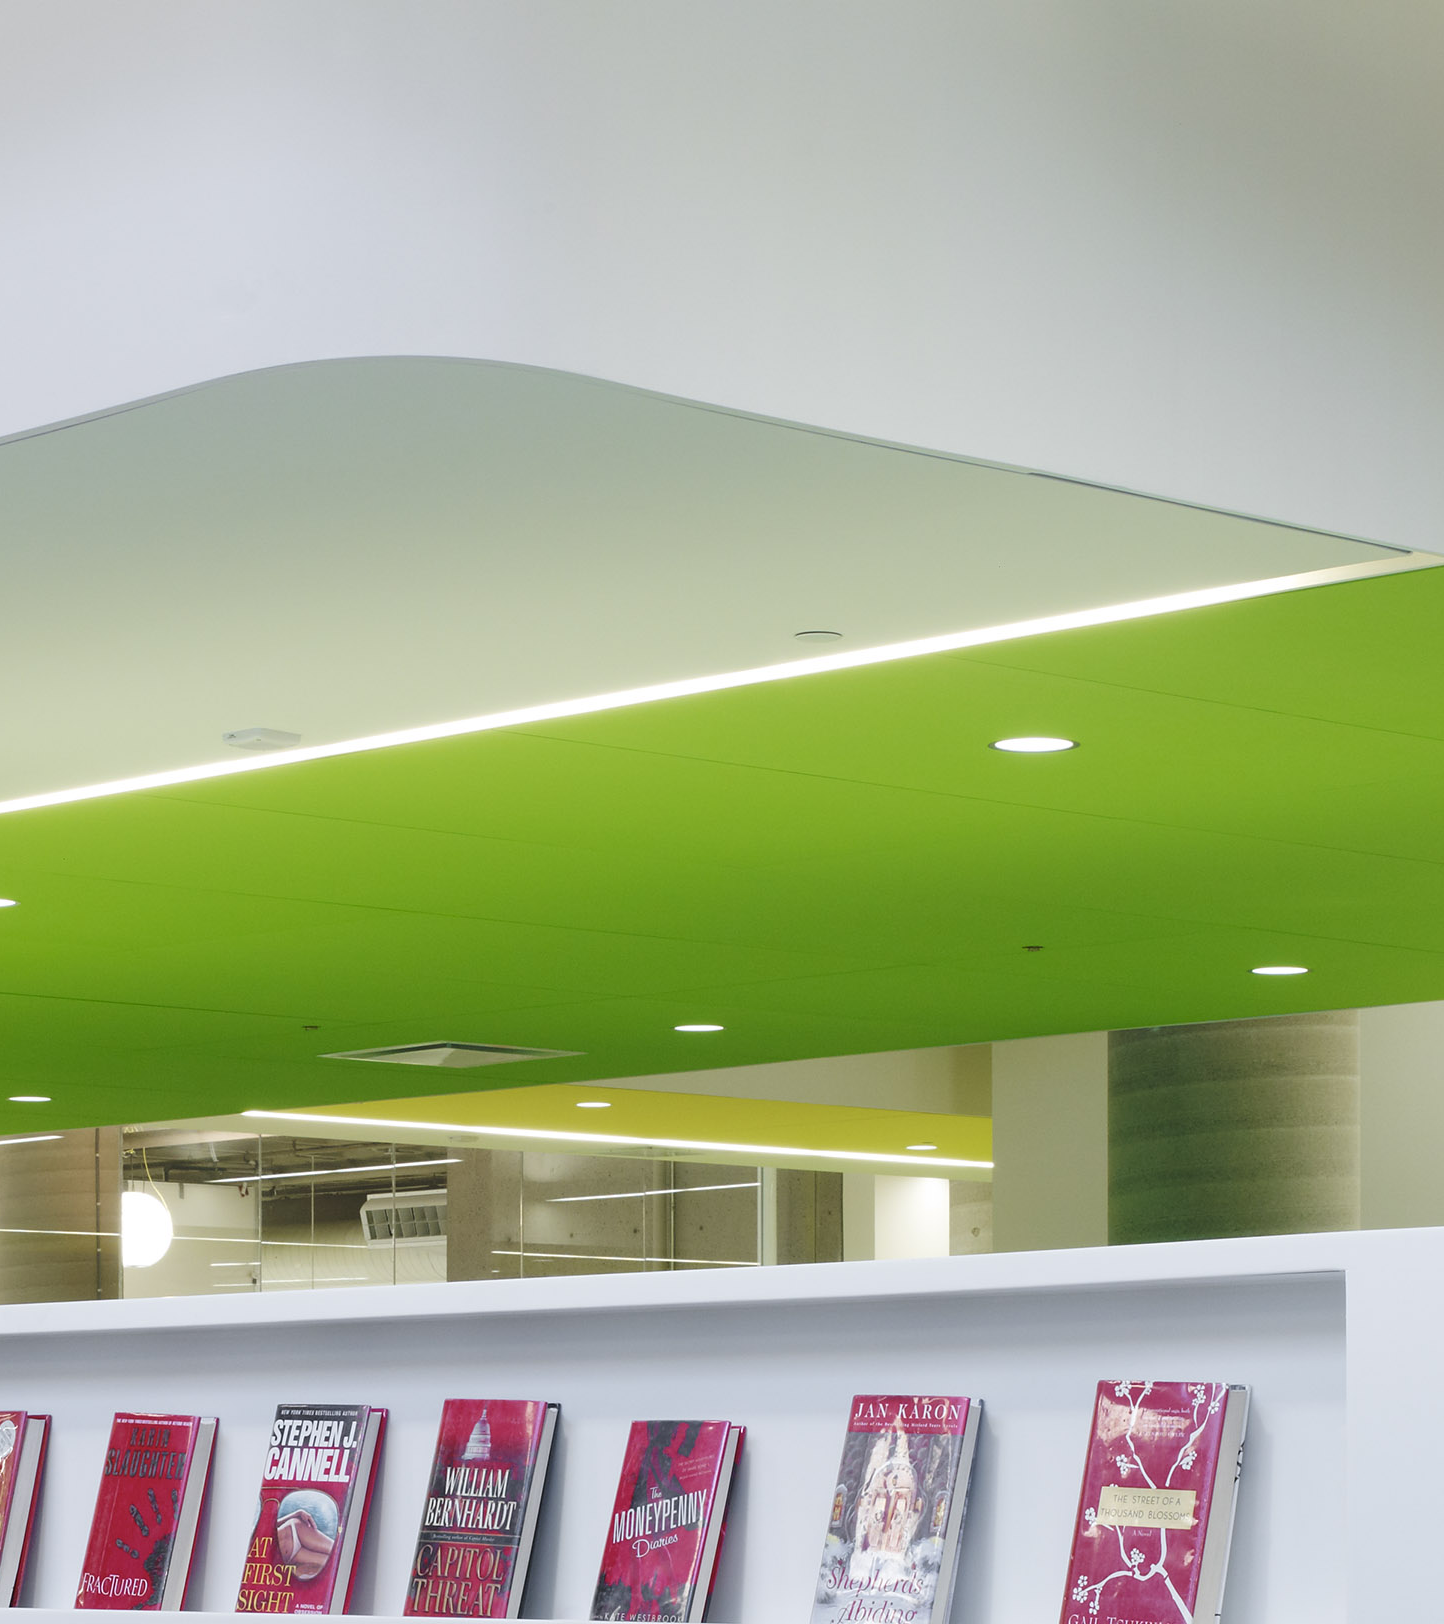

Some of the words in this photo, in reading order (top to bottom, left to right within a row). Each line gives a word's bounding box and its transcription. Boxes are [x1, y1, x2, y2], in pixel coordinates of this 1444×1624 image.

[855, 1403, 889, 1418] JAN
[897, 1403, 962, 1420] KARON
[130, 1427, 171, 1447] KARIN
[270, 1419, 345, 1448] STEPHEN
[342, 1421, 357, 1449] J.
[105, 1448, 186, 1480] SLAUGHTER
[264, 1447, 350, 1483] CANNELL
[445, 1466, 510, 1499] WILLIAM
[650, 1486, 663, 1500] The
[1114, 1494, 1128, 1504] THE
[1132, 1495, 1160, 1505] STREET
[1161, 1497, 1174, 1506] OF
[1175, 1498, 1181, 1506] A
[424, 1497, 517, 1531] BERNHARDT
[612, 1489, 707, 1544] MONEYPENNY
[1100, 1508, 1145, 1519] THOUSAND
[1148, 1510, 1190, 1521] BLOSSOMS
[247, 1536, 273, 1558] AT
[631, 1534, 679, 1558] Diaries
[241, 1563, 297, 1587] FIRST
[416, 1544, 504, 1581] CAPITOL
[83, 1572, 148, 1598] FRACTURED
[826, 1566, 924, 1598] Shepherds
[236, 1589, 294, 1613] SIGHT
[412, 1578, 501, 1617] THREAT
[629, 1613, 684, 1623] WESTBROOK
